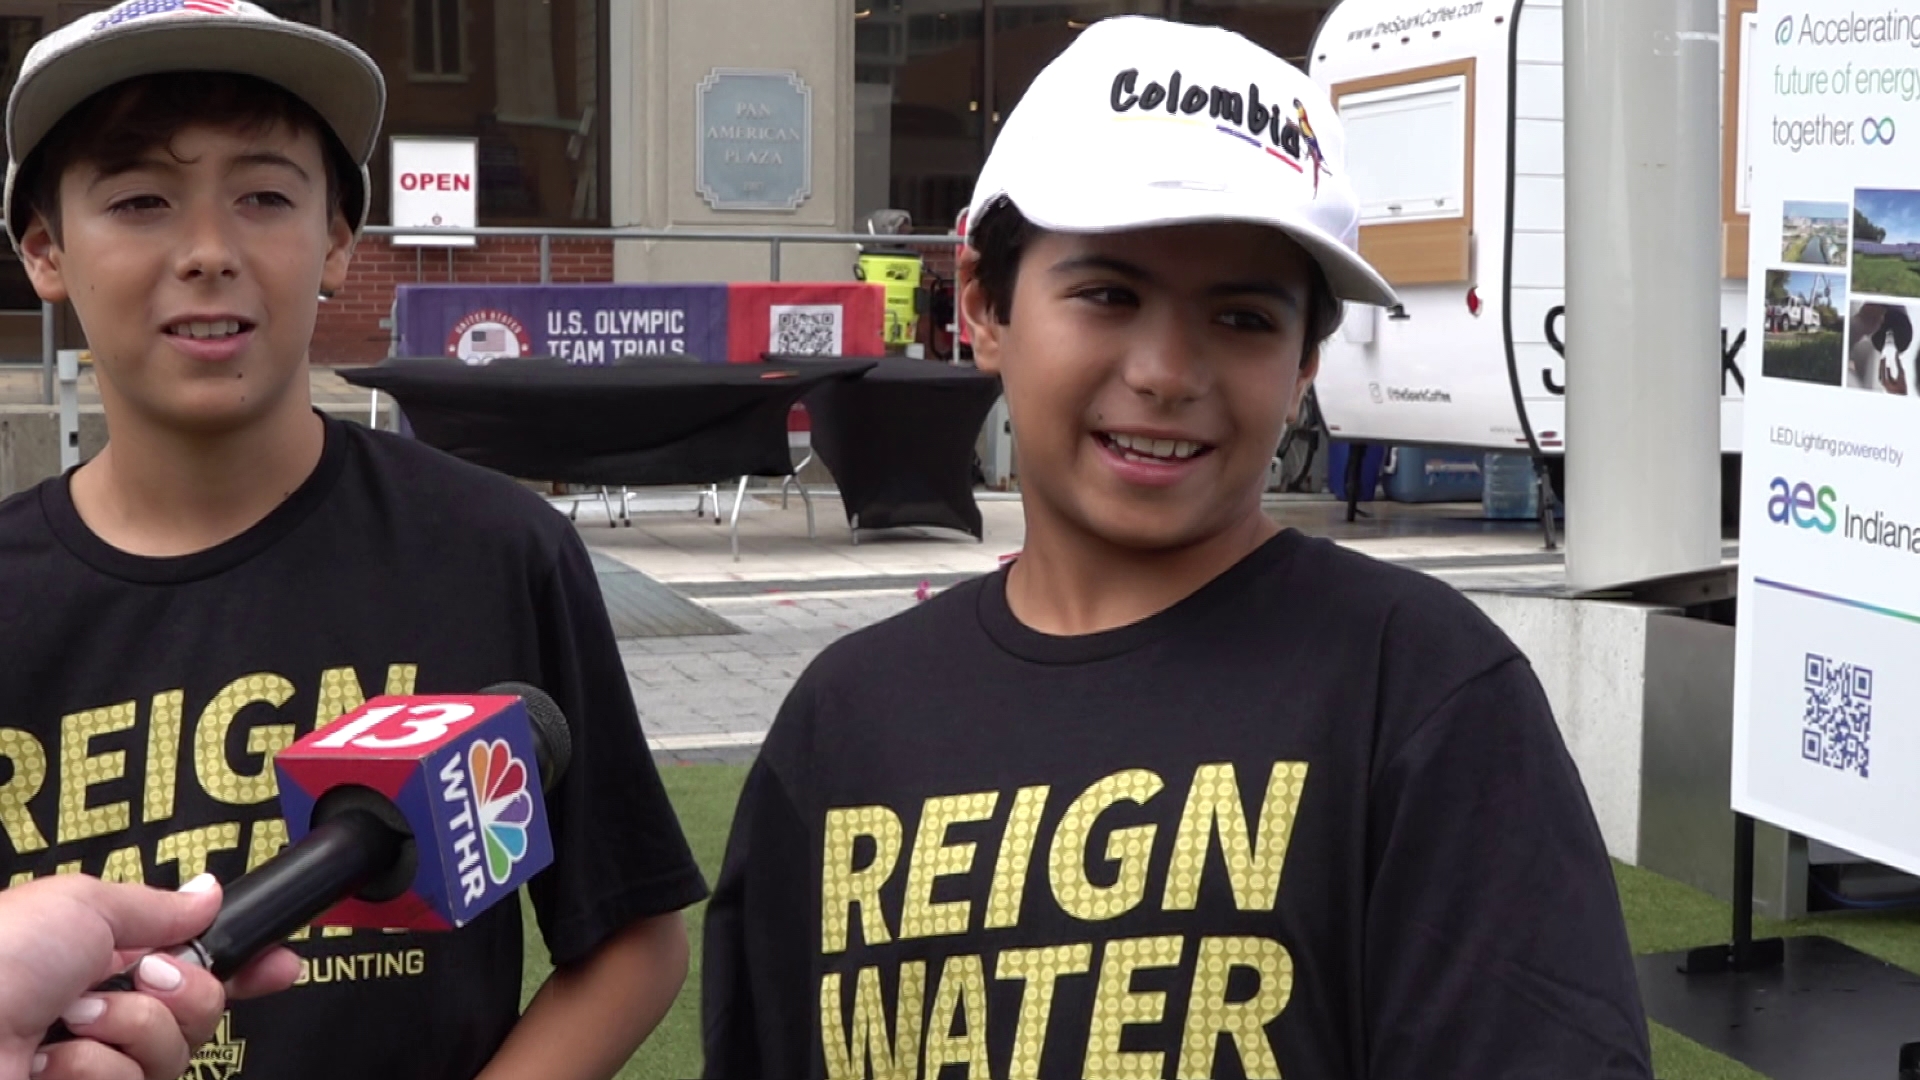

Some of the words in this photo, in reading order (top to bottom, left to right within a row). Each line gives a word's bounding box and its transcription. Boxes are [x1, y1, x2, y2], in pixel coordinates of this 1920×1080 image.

[1798, 8, 1920, 48] Accelerating
[1774, 64, 1829, 95] future
[1832, 62, 1852, 94] of
[736, 101, 770, 117] PAN
[1110, 68, 1301, 160] Colombia
[707, 126, 801, 141] AMERICAN
[1772, 114, 1855, 153] together.
[725, 149, 783, 165] PLAZA
[399, 172, 471, 192] OPEN
[547, 309, 588, 335] U.S.
[594, 309, 685, 335] OLYMPIC
[546, 340, 605, 364] TEAM
[1769, 425, 1794, 446] LED
[1795, 429, 1837, 457] Lighting
[1838, 440, 1887, 462] powered
[1888, 446, 1904, 467] by
[1767, 476, 1838, 534] aes
[1844, 504, 1920, 554] Indiana
[309, 703, 476, 748] 13
[440, 752, 487, 908] WTHR
[821, 761, 1309, 954] REIGN
[291, 949, 425, 987] OUNTING
[820, 935, 1294, 1080] WATER
